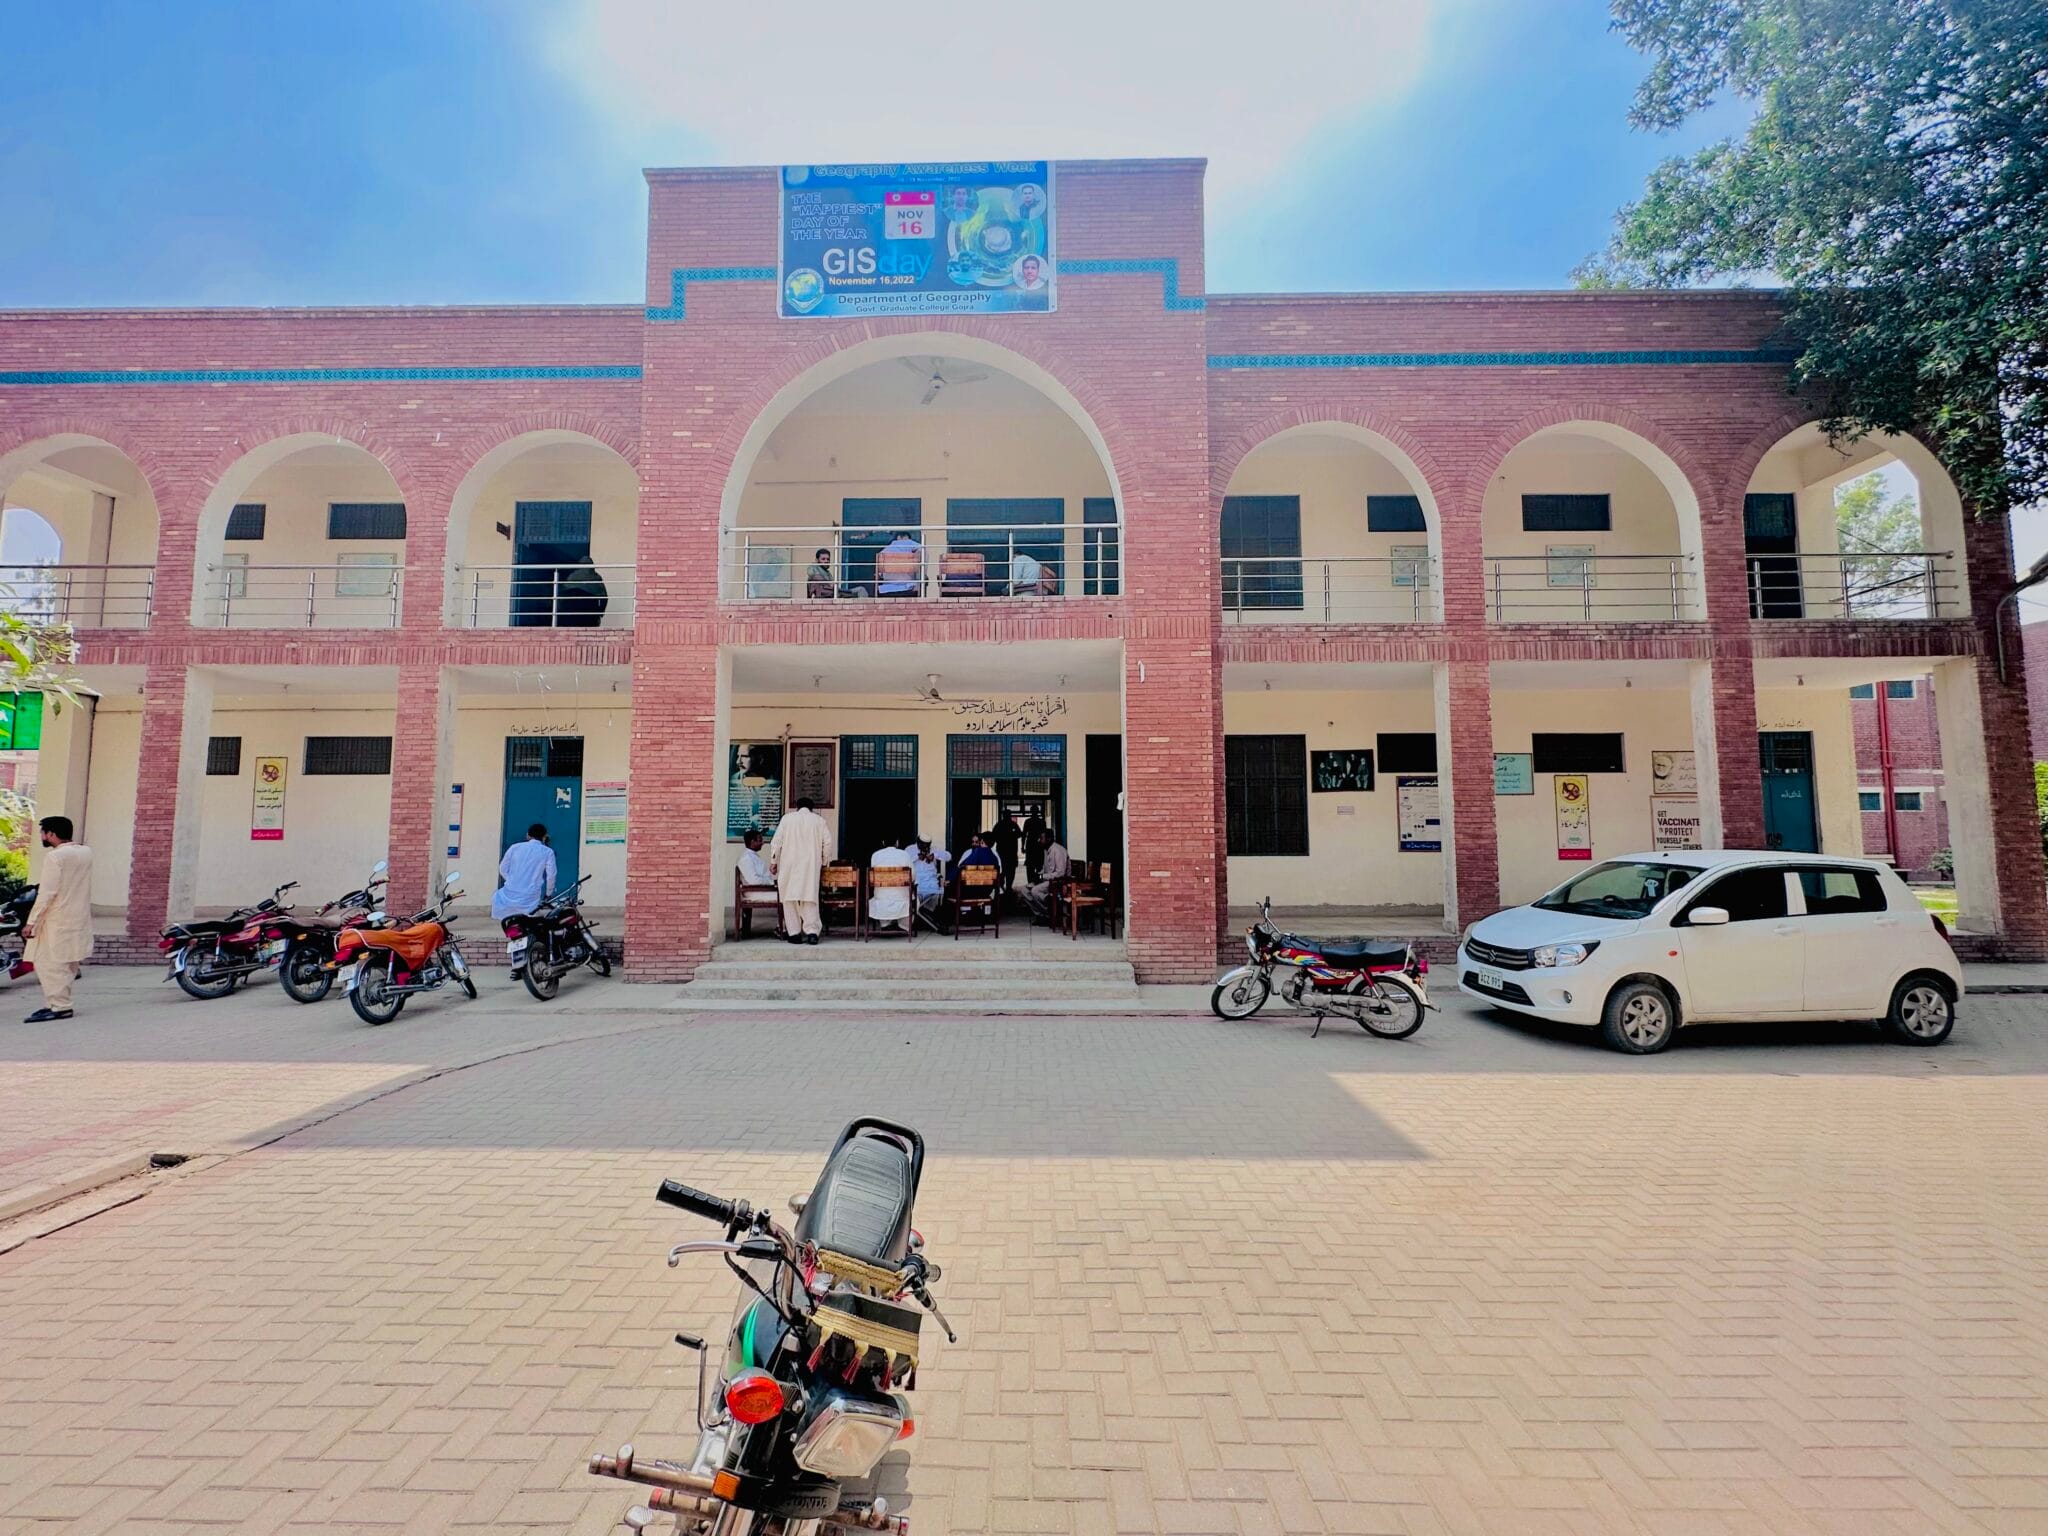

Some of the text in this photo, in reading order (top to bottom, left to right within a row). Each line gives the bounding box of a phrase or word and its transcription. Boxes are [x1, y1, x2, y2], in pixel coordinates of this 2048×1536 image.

[814, 160, 1037, 179] Geography Awareness Week
[791, 192, 822, 205] THE
[897, 210, 923, 219] NOV
[791, 215, 849, 229] DAY OF
[900, 221, 922, 235] 16
[791, 228, 867, 240] THE YEAR
[828, 277, 876, 286] November
[838, 291, 991, 306] Department of Geography
[919, 304, 950, 312] College
[1665, 828, 1693, 836] PROTECT
